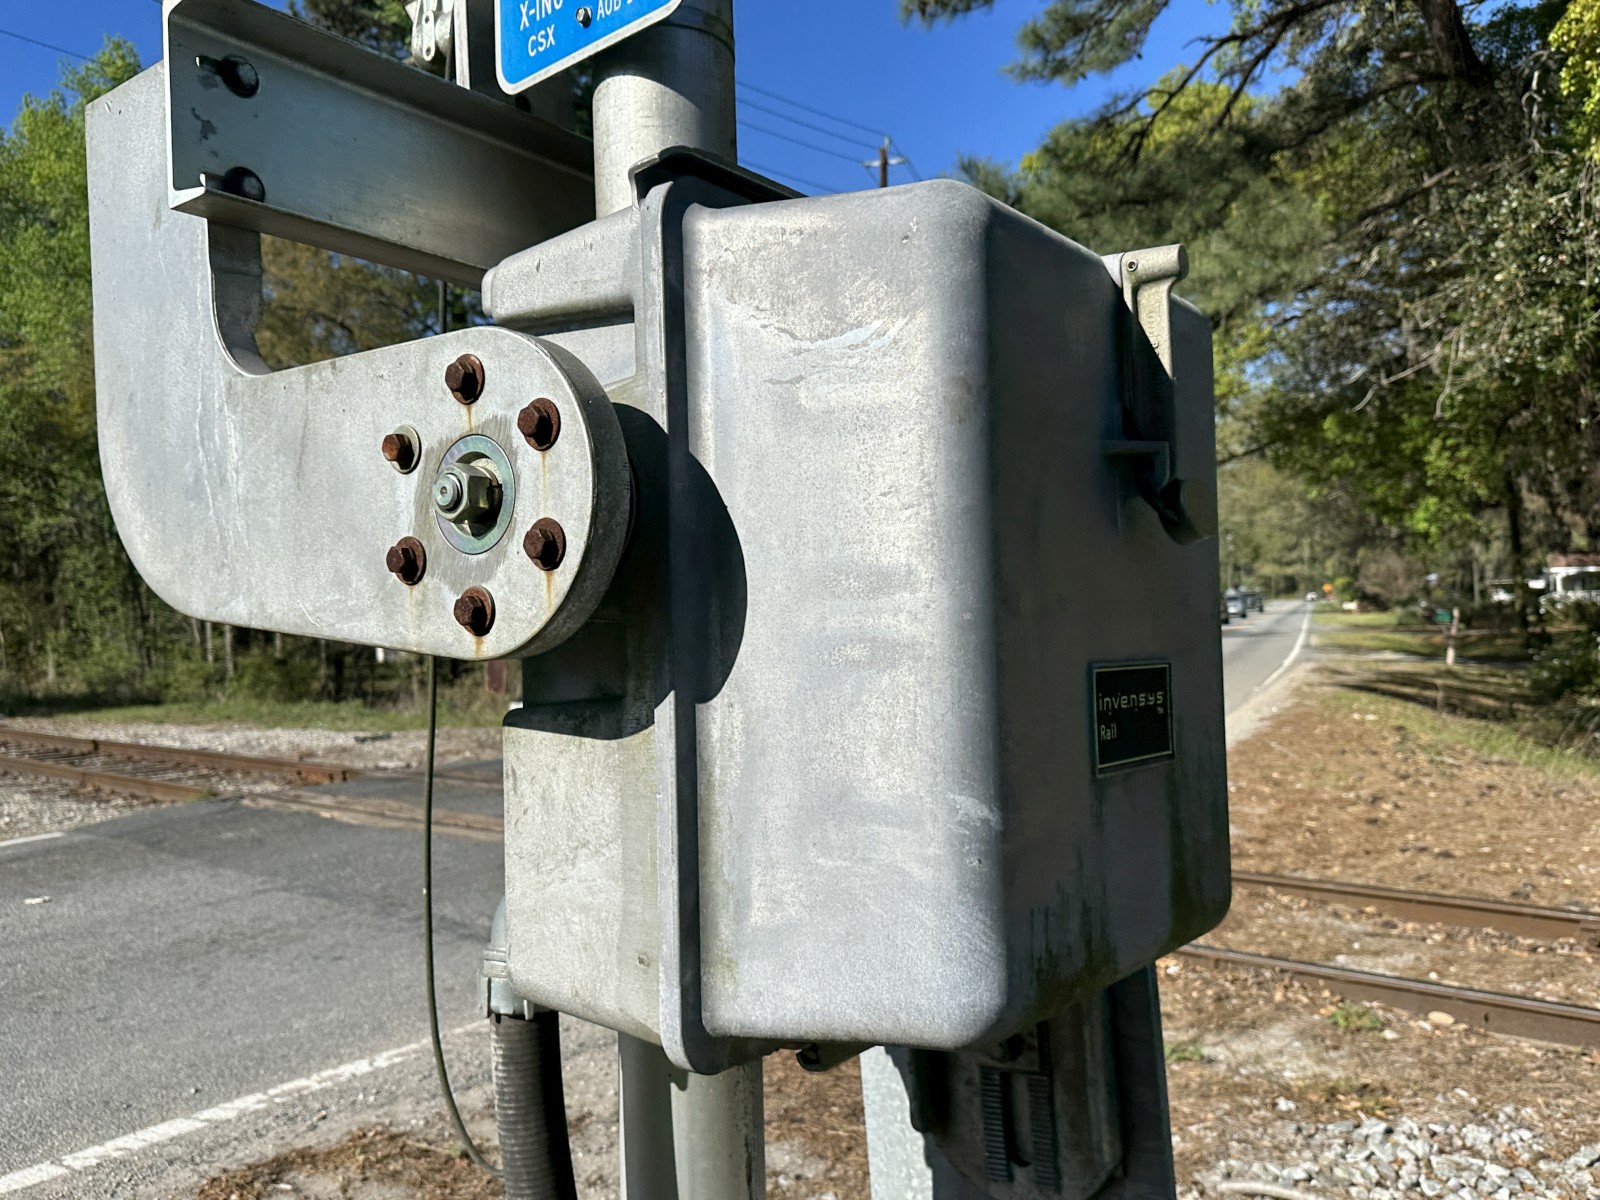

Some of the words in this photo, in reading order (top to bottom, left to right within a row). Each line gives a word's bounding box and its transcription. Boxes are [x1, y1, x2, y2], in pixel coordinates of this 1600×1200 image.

[528, 24, 556, 57] CSX
[1098, 691, 1165, 711] invensys
[1100, 723, 1118, 741] Rail
